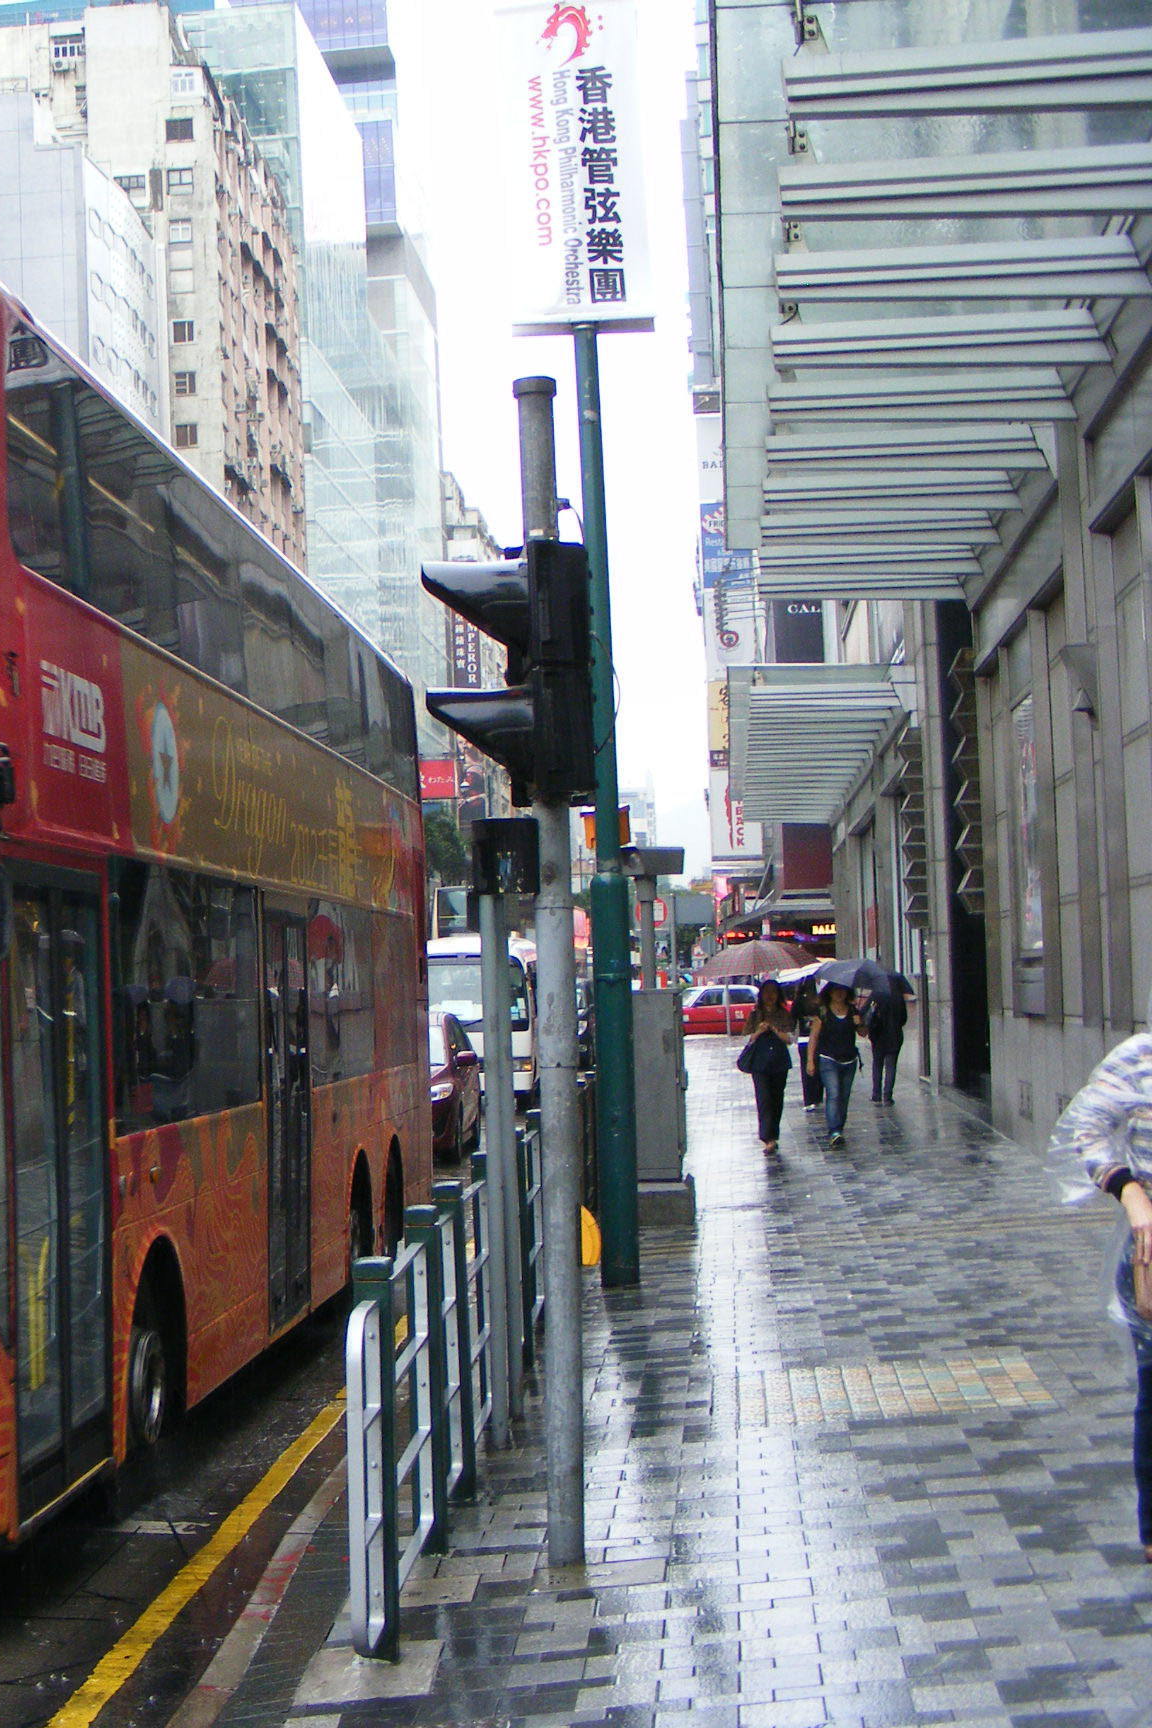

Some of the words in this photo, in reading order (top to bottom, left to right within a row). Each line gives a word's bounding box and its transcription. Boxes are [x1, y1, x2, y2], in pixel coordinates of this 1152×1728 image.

[551, 68, 570, 105] Hong
[553, 107, 574, 145] Kong
[528, 75, 553, 247] www.hkpo.com
[558, 145, 578, 234] Philharmonic
[575, 66, 626, 304] 香港管弦樂團
[564, 237, 583, 306] Orchestra
